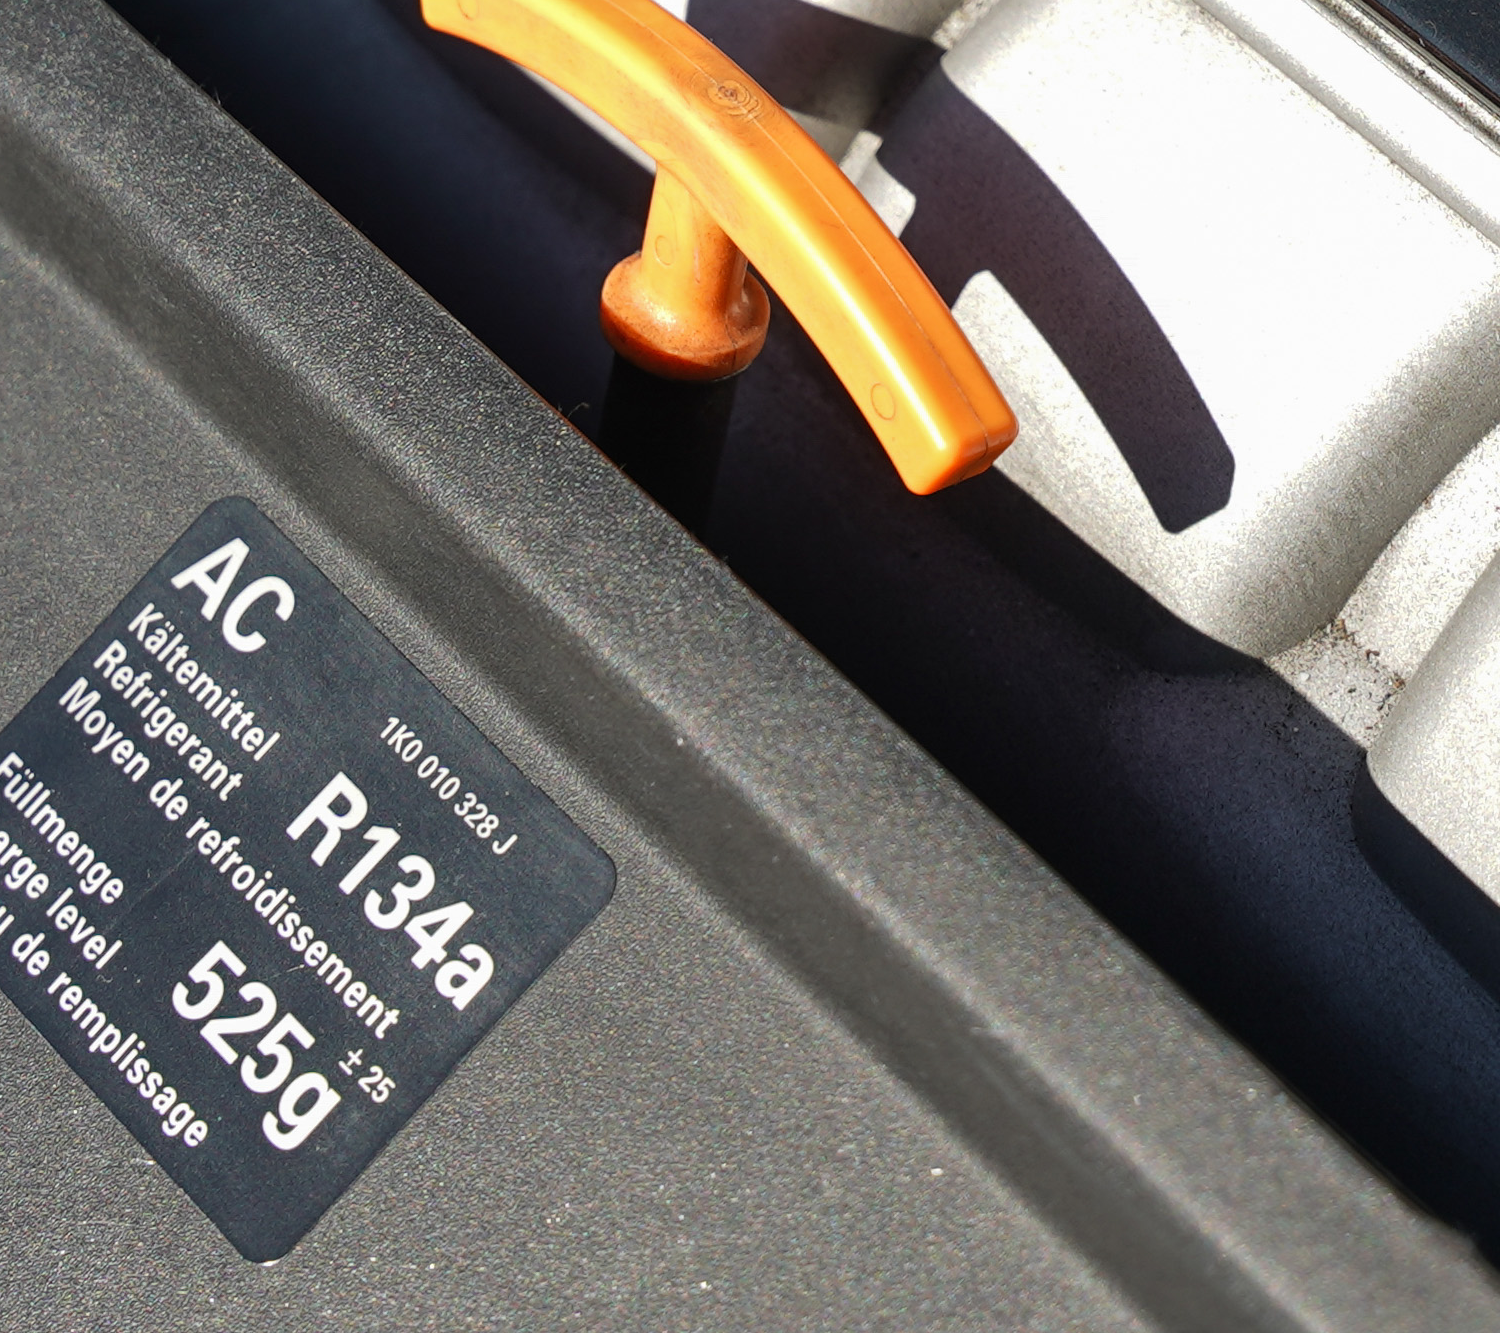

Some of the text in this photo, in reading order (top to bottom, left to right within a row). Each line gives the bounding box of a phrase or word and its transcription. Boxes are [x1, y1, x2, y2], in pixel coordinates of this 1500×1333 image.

[170, 537, 296, 653] AC
[93, 639, 244, 802] Refrigerant
[127, 602, 281, 763] Kältemittel
[58, 676, 400, 1040] Moyen de refroidissement
[380, 716, 518, 855] 1K0 010 328 J
[45, 887, 123, 970] level
[285, 771, 495, 1012] R134a
[11, 932, 51, 976] de
[47, 971, 208, 1147] remplissage
[171, 940, 342, 1151] 525g
